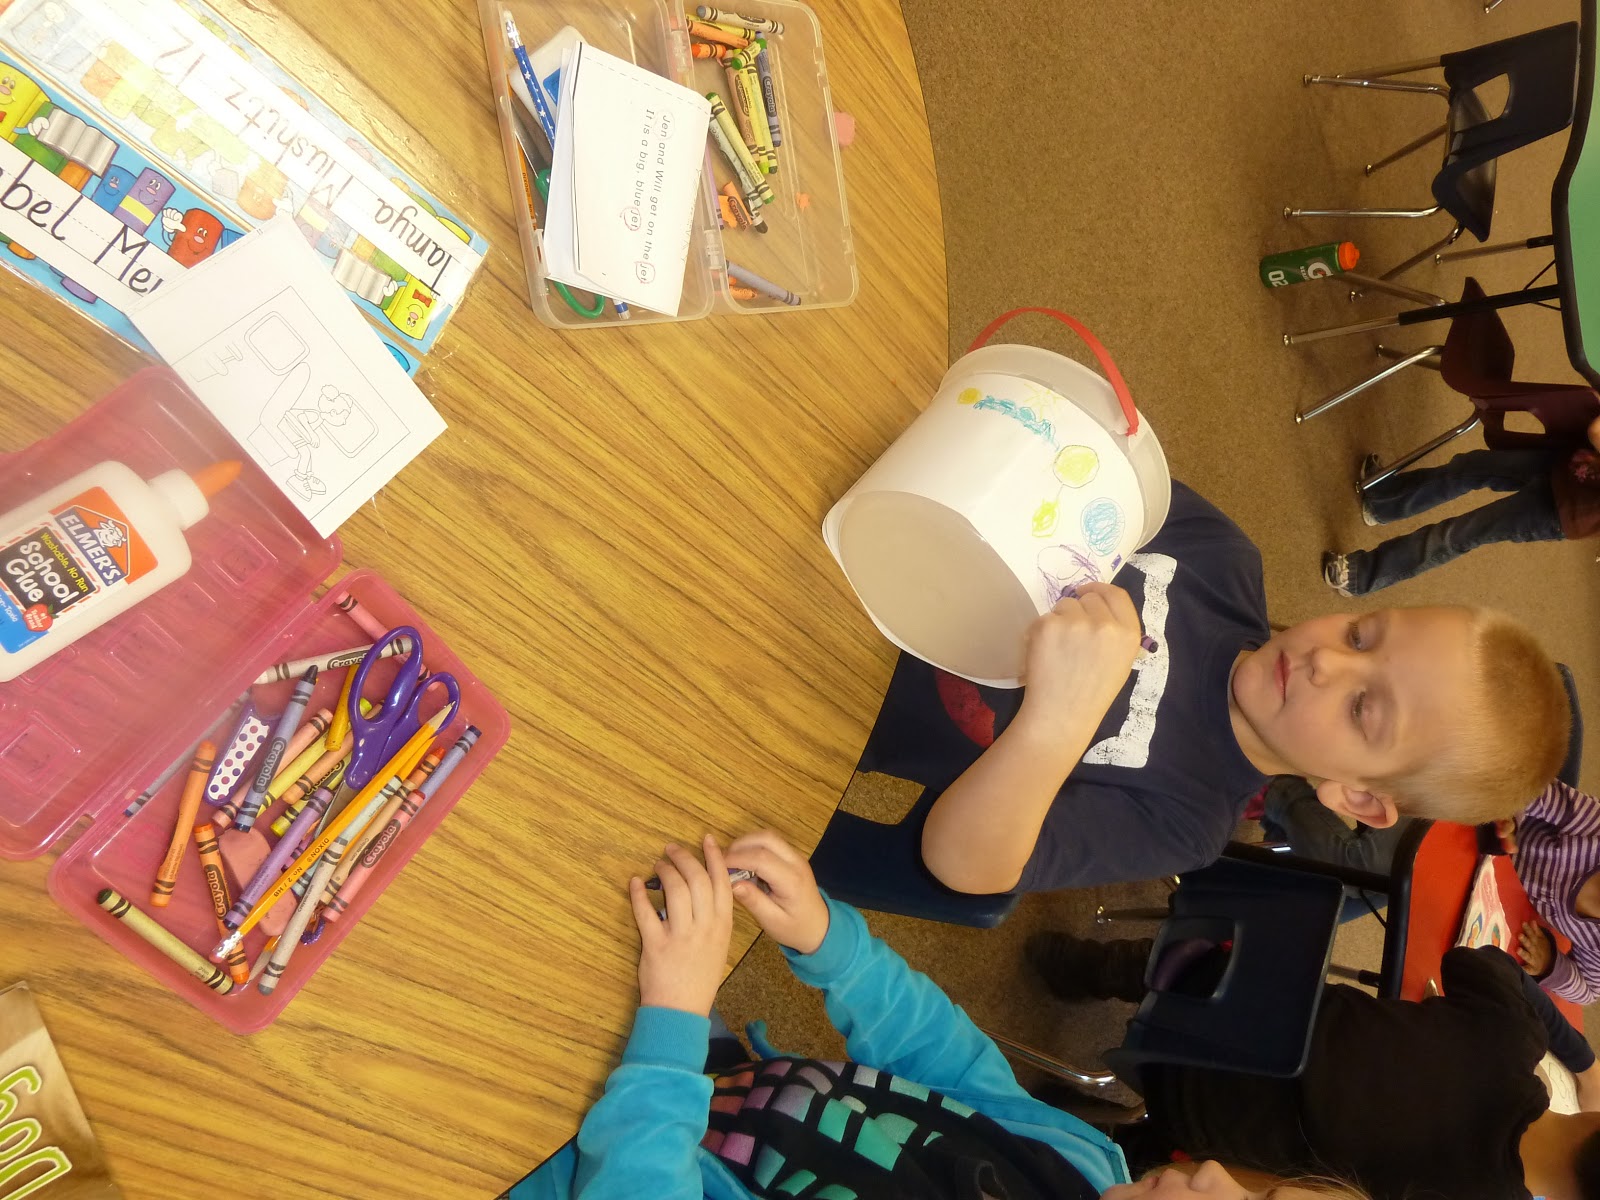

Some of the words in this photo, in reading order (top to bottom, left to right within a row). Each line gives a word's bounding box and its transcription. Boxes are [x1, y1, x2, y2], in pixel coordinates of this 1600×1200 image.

[764, 77, 776, 112] Crayola
[645, 109, 655, 120] It
[643, 123, 653, 135] is
[661, 115, 671, 138] Jen
[641, 139, 649, 147] a
[656, 142, 666, 165] and
[653, 170, 664, 192] Will
[0, 158, 84, 241] bel
[633, 180, 645, 207] blue
[649, 195, 658, 216] get
[630, 210, 639, 228] jet
[646, 221, 655, 236] on
[375, 198, 453, 296] Tamya
[642, 241, 652, 260] the
[640, 263, 649, 281] jet
[1268, 269, 1289, 288] 02
[1307, 261, 1334, 280] G
[60, 514, 121, 580] ELMER'S
[6, 558, 44, 602] Glue
[19, 541, 79, 604] School
[66, 566, 79, 579] No
[75, 577, 89, 592] Run
[257, 740, 285, 787] Crayola
[364, 825, 397, 866] Crayola
[207, 871, 227, 917] Crayola
